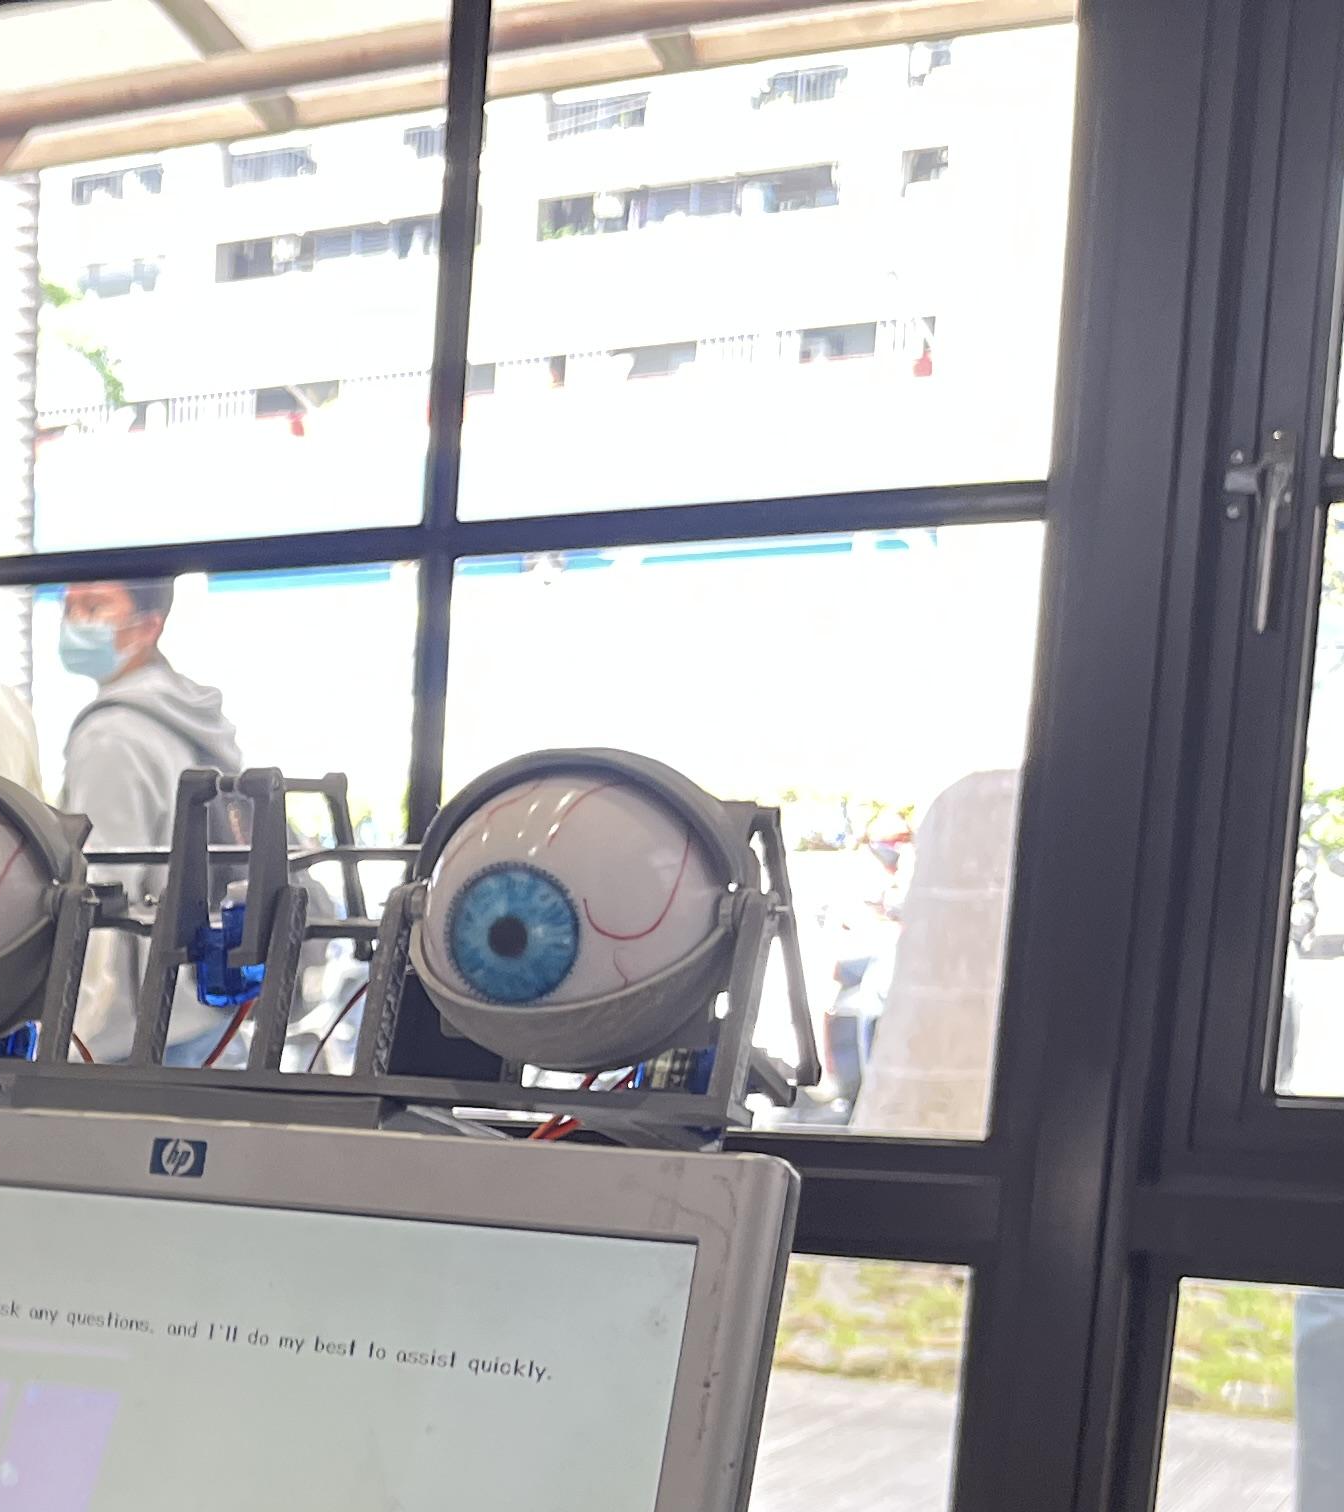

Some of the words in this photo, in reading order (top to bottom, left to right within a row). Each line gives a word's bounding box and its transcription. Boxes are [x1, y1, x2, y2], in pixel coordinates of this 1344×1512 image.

[29, 1306, 59, 1325] any
[167, 1321, 199, 1339] and
[208, 1323, 238, 1342] I'll
[247, 1329, 270, 1346] do
[278, 1336, 305, 1354] my
[314, 1336, 356, 1357] best
[368, 1341, 386, 1360] to
[396, 1349, 457, 1368] assist
[468, 1356, 552, 1384] quickly.
